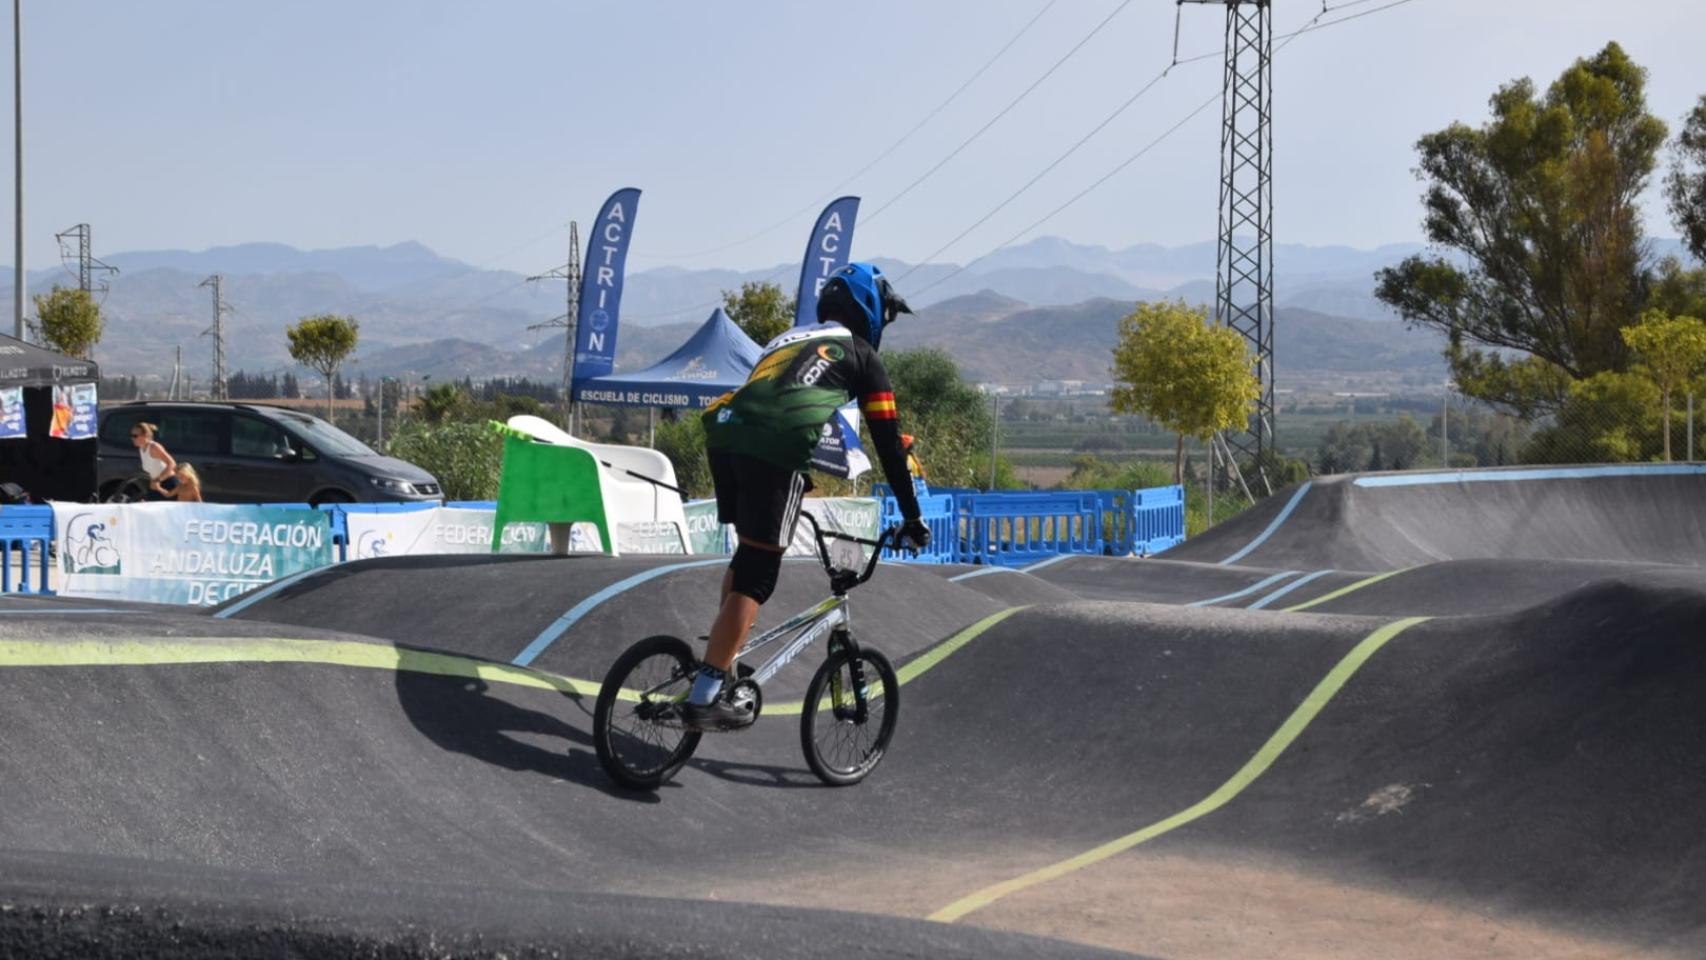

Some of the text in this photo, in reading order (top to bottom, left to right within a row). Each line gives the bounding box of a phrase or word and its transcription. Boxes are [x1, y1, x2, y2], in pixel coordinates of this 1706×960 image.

[580, 390, 625, 402] ESCUELA
[627, 391, 640, 403] DE
[642, 393, 689, 406] CICLISMO
[184, 520, 323, 548] FEDERACIÓN
[150, 549, 274, 576] ANDALUZA
[187, 581, 218, 605] DE
